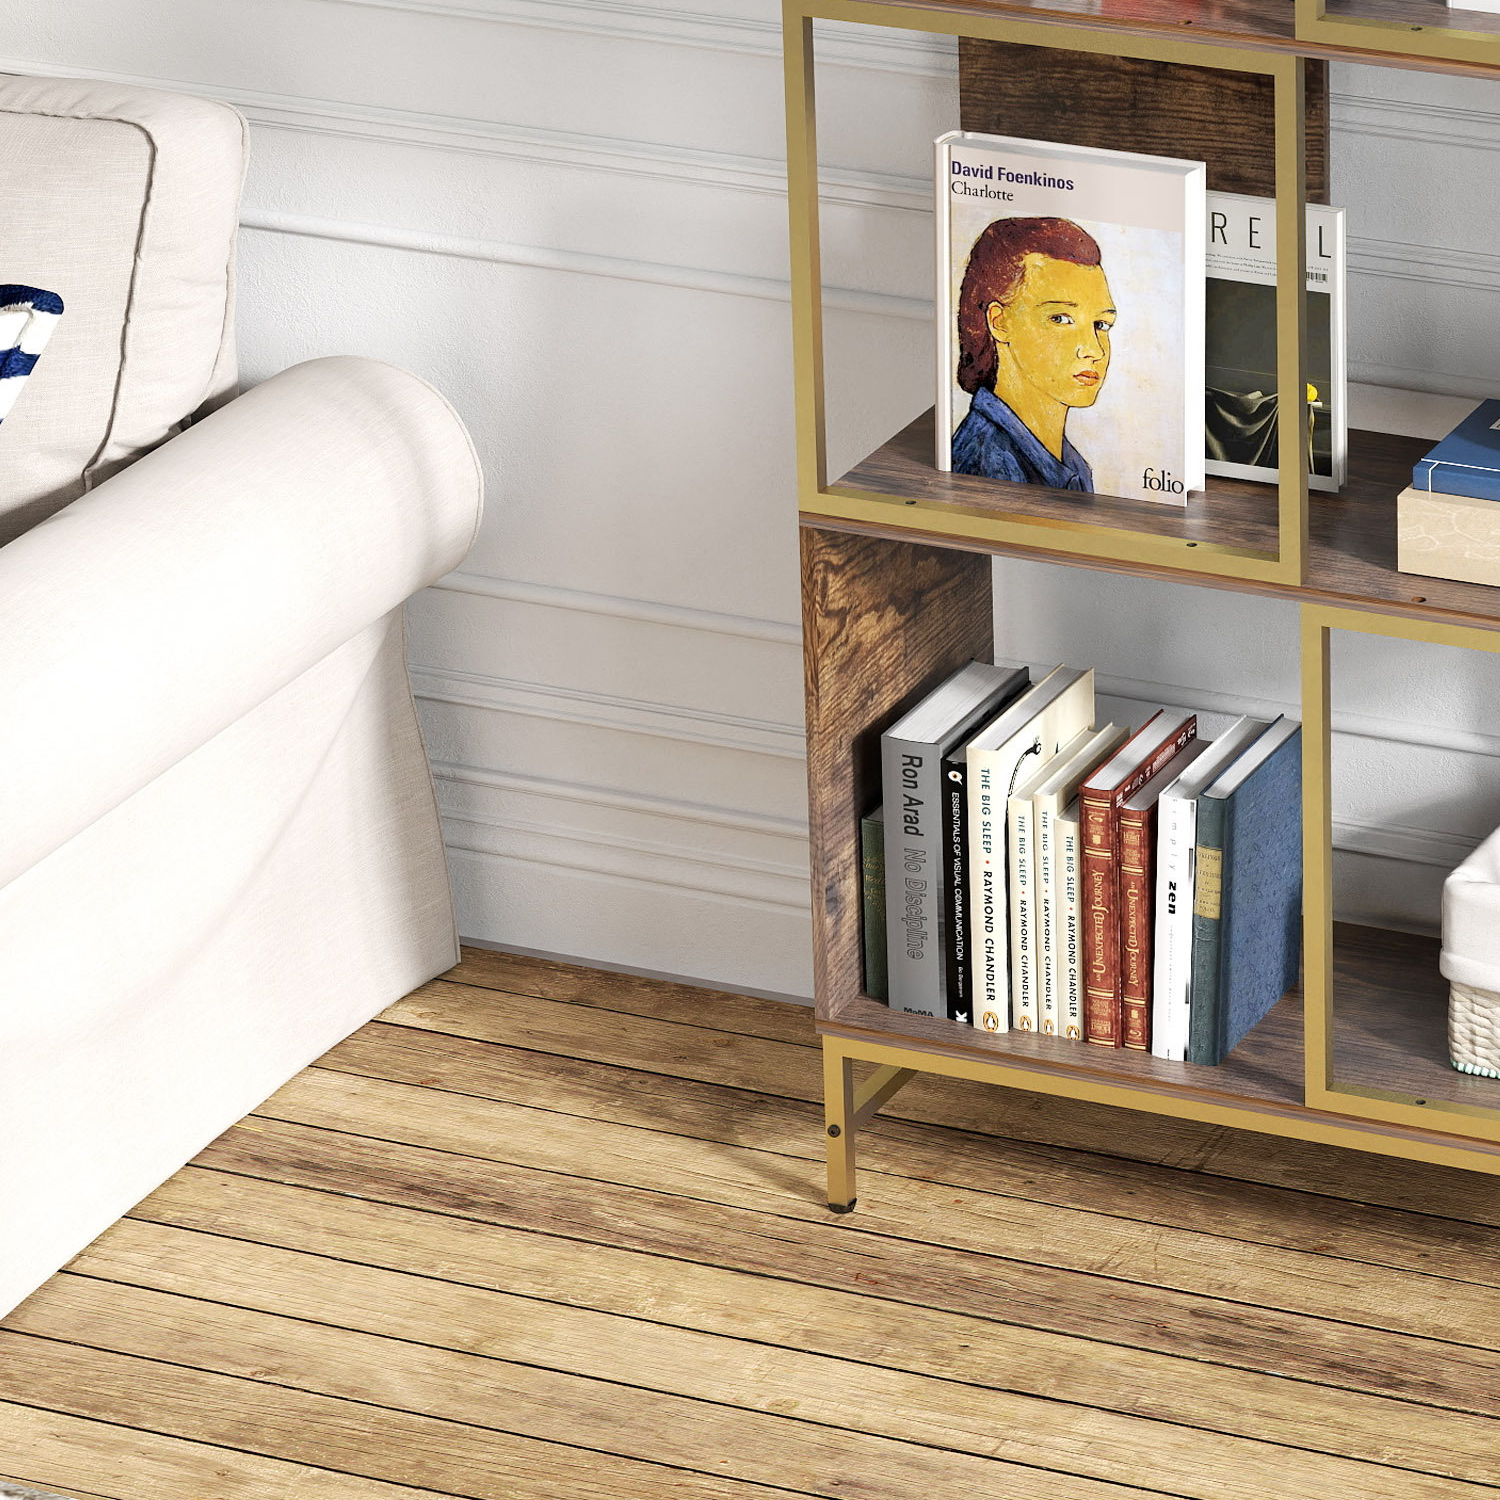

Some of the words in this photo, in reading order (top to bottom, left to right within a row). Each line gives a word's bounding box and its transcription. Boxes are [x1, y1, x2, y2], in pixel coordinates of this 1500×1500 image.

[951, 160, 993, 179] David
[997, 166, 1075, 190] Foenkinos
[951, 180, 1014, 201] Charlotte
[1142, 467, 1184, 495] folio
[902, 753, 923, 790] Ron
[980, 768, 991, 790] THE
[903, 793, 924, 837] Arad
[951, 791, 961, 843] ESSENTIALS
[981, 794, 991, 815] BIG
[953, 844, 962, 856] OF
[982, 820, 992, 854] SLEEP
[1018, 837, 1026, 854] BIG
[1065, 835, 1074, 853] THE
[904, 847, 927, 873] No
[953, 857, 962, 887] VISUAL
[1019, 858, 1027, 886] SLEEP
[1066, 856, 1075, 873] BIG
[983, 871, 994, 933] RAYMOND
[1066, 876, 1075, 903] SLEEP
[1168, 880, 1177, 915] zen
[901, 877, 929, 960] Discipline
[953, 887, 964, 961] COMMUNICATION
[1020, 899, 1028, 951] RAYMOND
[1043, 898, 1051, 952] RAYMOND
[1067, 915, 1076, 965] RAYMOND
[984, 938, 996, 1001] CHANDLER
[1021, 954, 1029, 1007] CHANDLER
[1044, 955, 1052, 1010] CHANDLER
[1068, 968, 1077, 1018] CHANDLER
